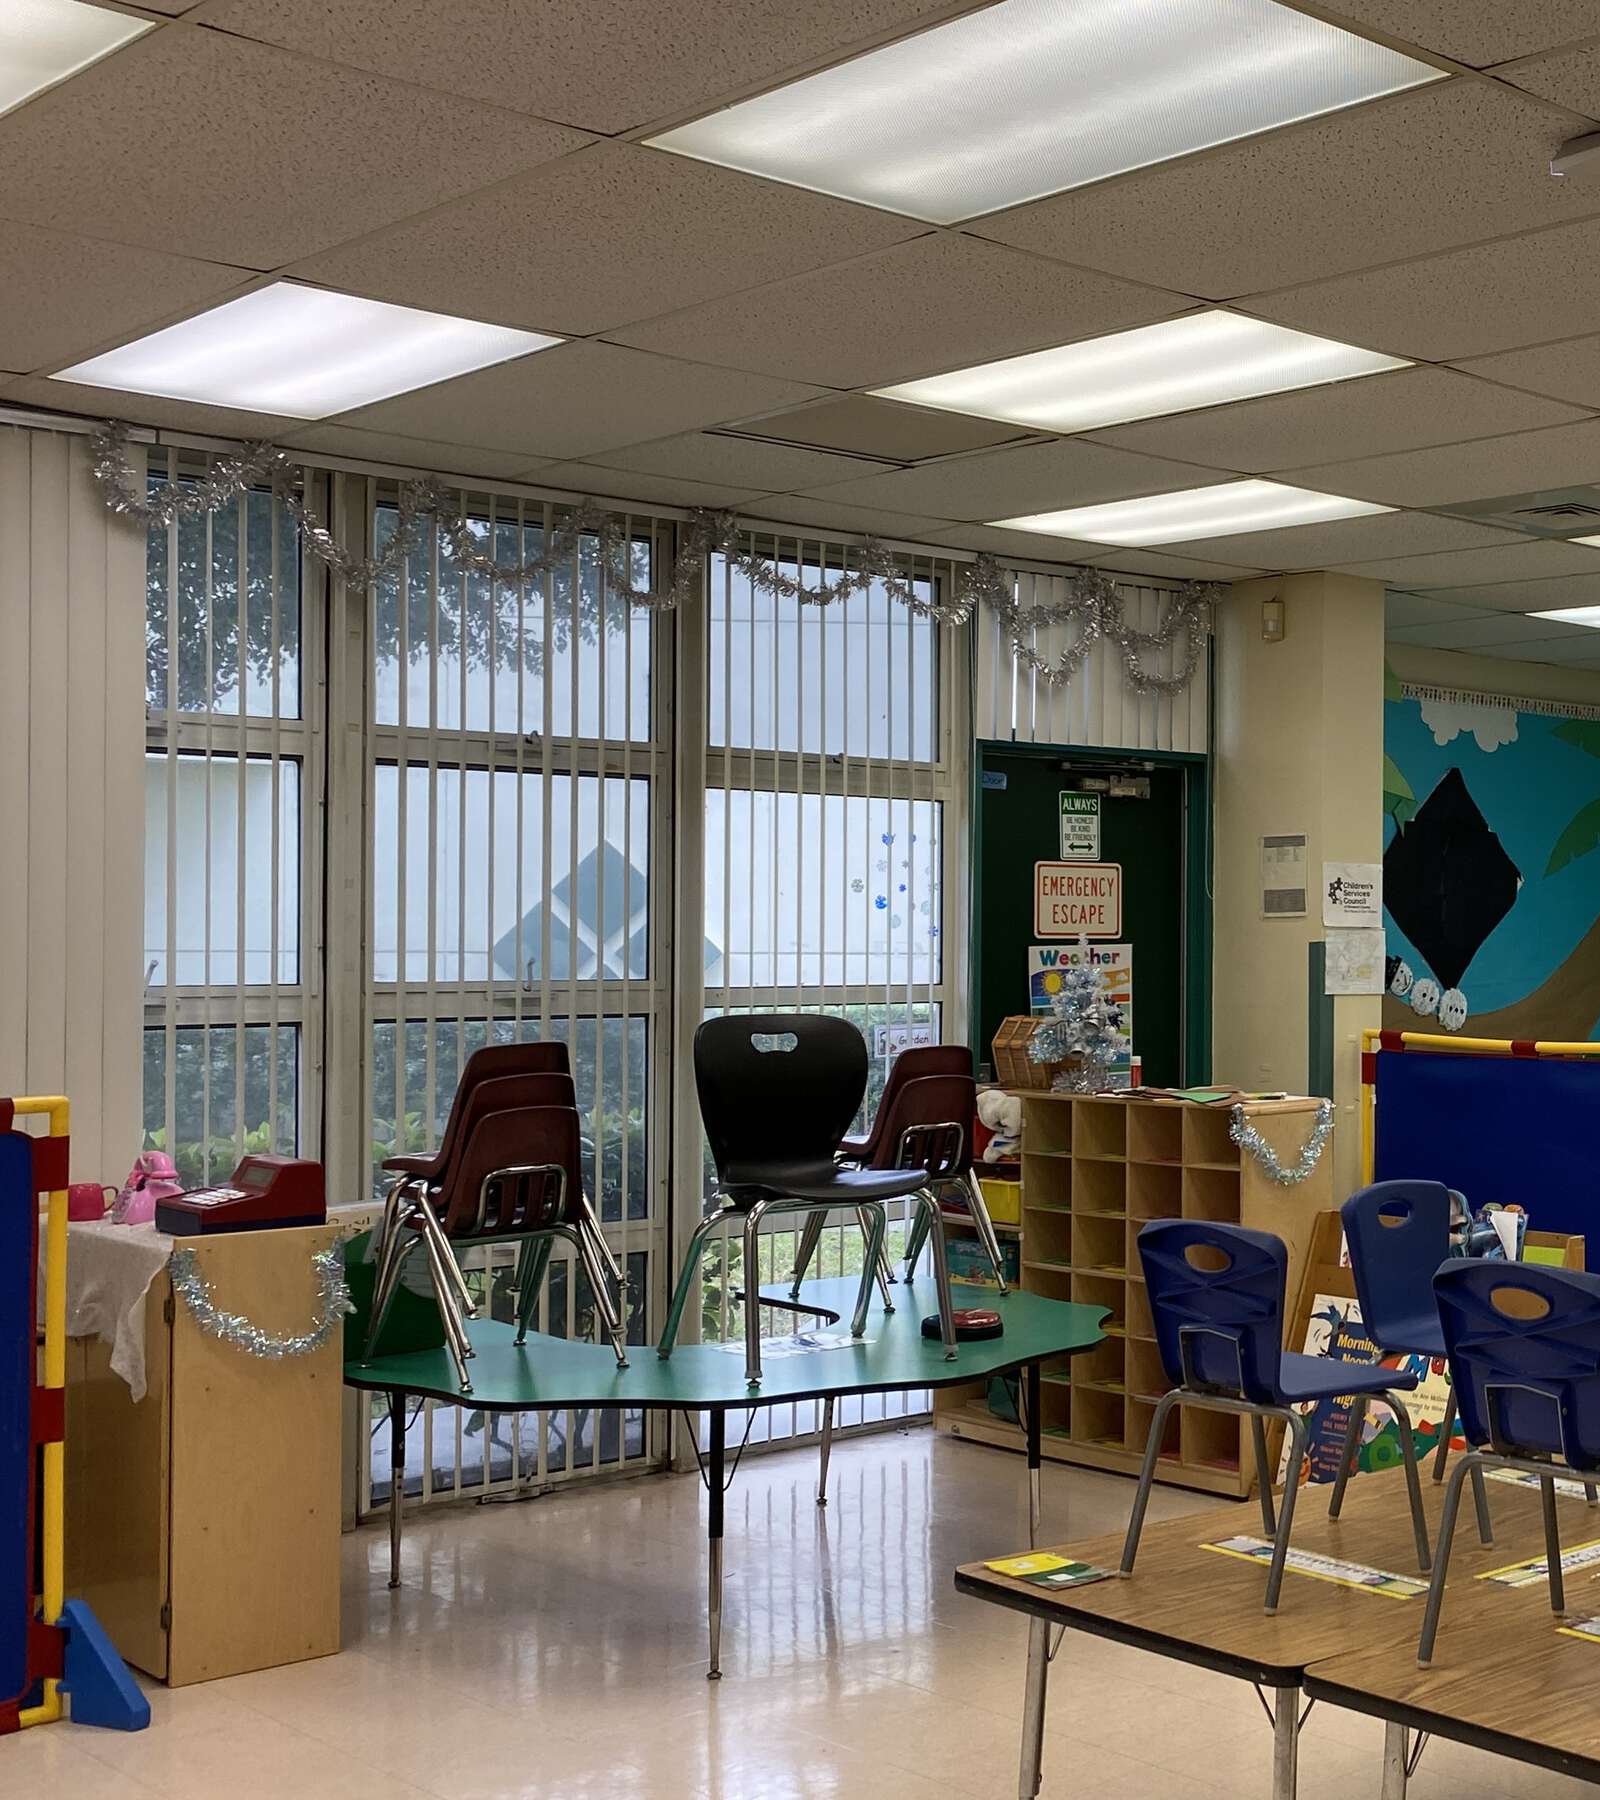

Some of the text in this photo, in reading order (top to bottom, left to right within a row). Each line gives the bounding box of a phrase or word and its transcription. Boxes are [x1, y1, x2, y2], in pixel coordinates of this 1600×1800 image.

[1062, 797, 1098, 812] ALWAYS
[1042, 875, 1114, 897] EMERGENCY
[1343, 881, 1373, 890] Children's
[1343, 889, 1371, 897] Services
[1052, 903, 1105, 925] ESCAPE
[1039, 948, 1120, 967] Weaher
[899, 1034, 929, 1045] Gden
